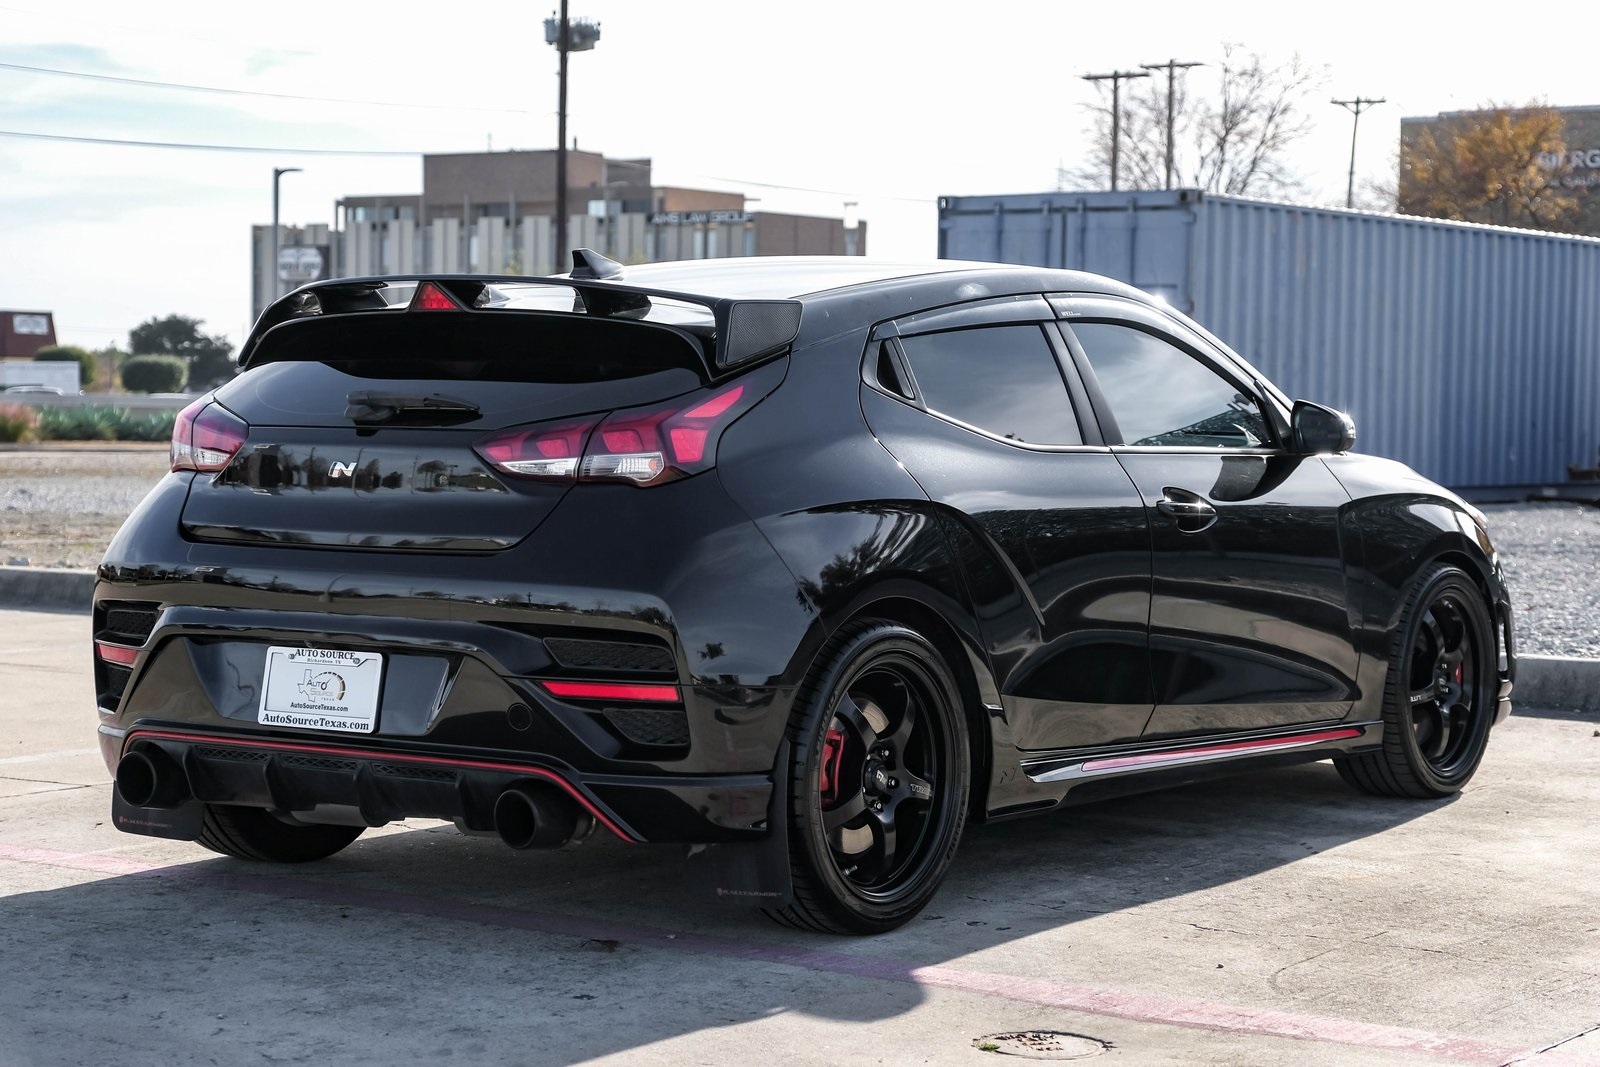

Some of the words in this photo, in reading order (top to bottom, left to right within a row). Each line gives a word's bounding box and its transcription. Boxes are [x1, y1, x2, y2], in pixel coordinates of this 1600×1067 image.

[328, 461, 357, 478] N
[295, 649, 319, 658] AUTO
[319, 650, 356, 660] SOURCE
[290, 702, 348, 711] AutoSourceTexas.com
[262, 714, 369, 730] AutoSourceTexas.com
